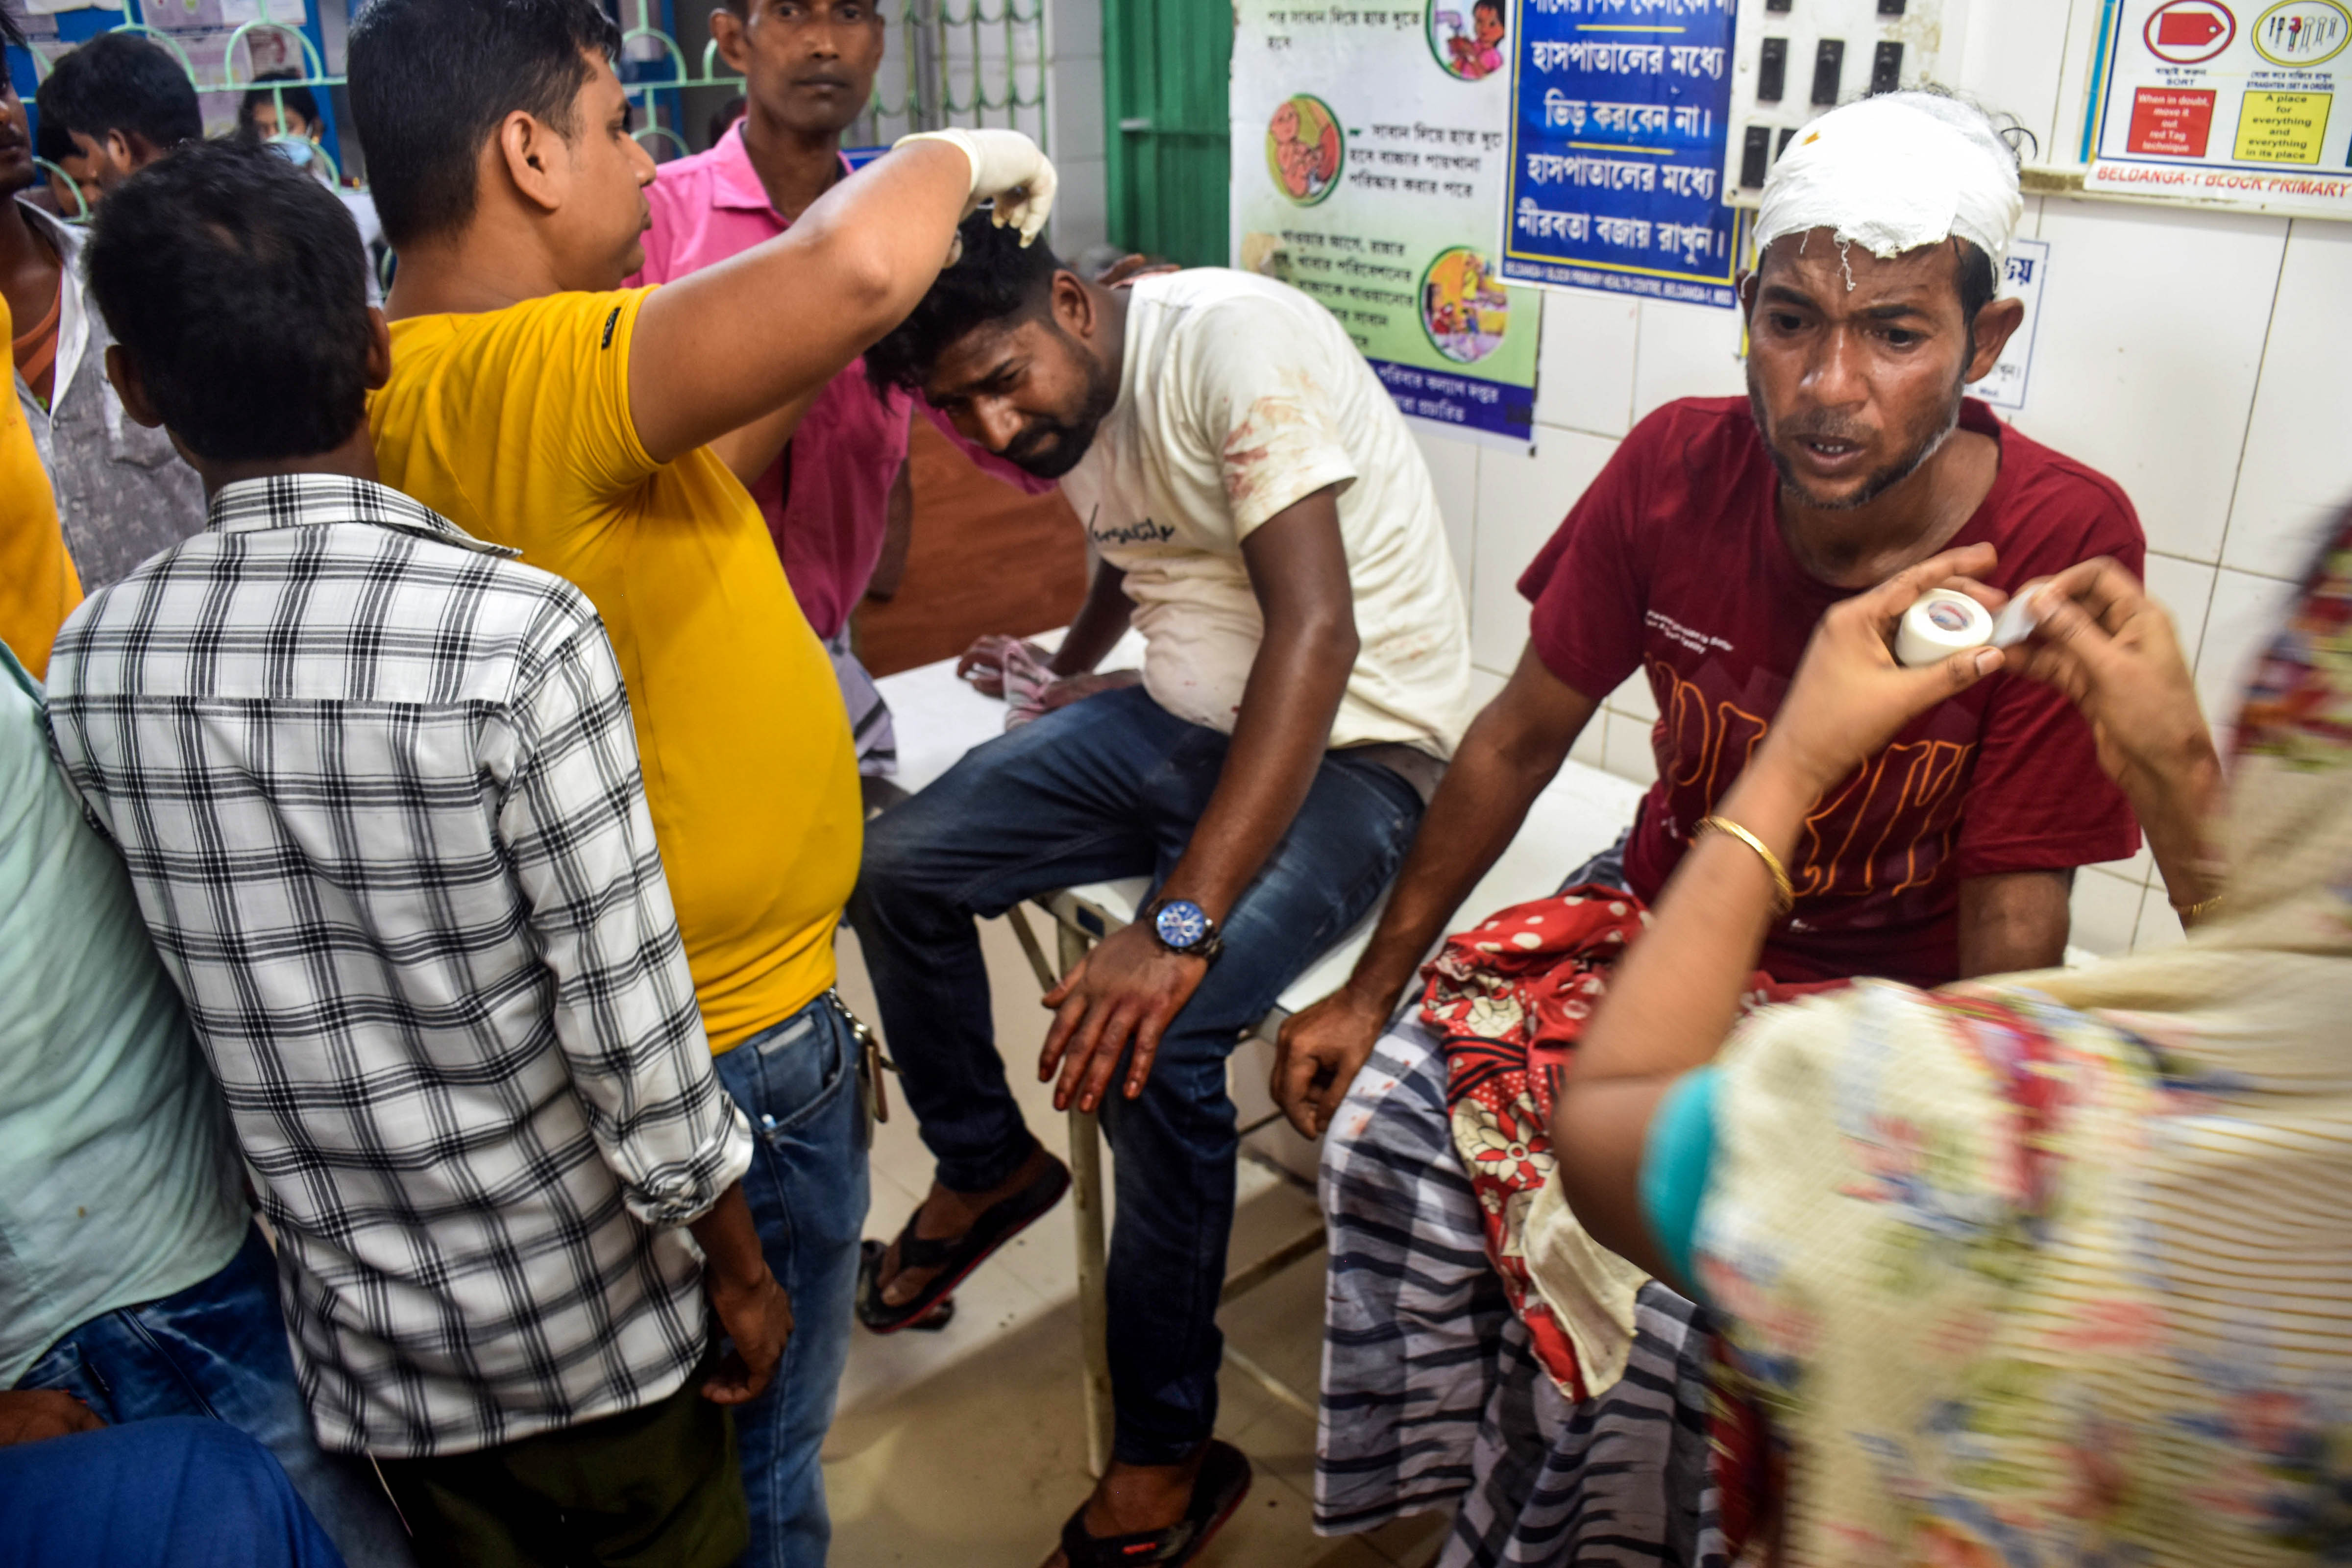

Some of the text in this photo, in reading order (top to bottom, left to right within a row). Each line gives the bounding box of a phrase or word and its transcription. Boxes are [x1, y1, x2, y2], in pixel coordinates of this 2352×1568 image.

[1530, 40, 1726, 80] হাসপাতালের মধ্যে
[2166, 78, 2195, 86] SORT
[2138, 93, 2166, 104] When
[2166, 95, 2177, 105] in
[2277, 95, 2307, 104] place
[1544, 87, 1587, 135] ভিড়
[1591, 101, 1670, 136] করবেন
[2154, 108, 2189, 117] move it
[2161, 119, 2179, 128] out
[2253, 117, 2312, 128] everything
[2149, 130, 2187, 143] red Tag
[2142, 140, 2190, 153] technique
[2248, 138, 2307, 149] everything
[2275, 150, 2306, 159] place
[1526, 152, 1716, 201] হাসপাতালের মধ্যে
[2205, 173, 2262, 191] BLOCK
[2267, 178, 2352, 197] PRIMARY
[1516, 197, 1591, 244] নীরবতা
[1594, 214, 1652, 250] বজায়
